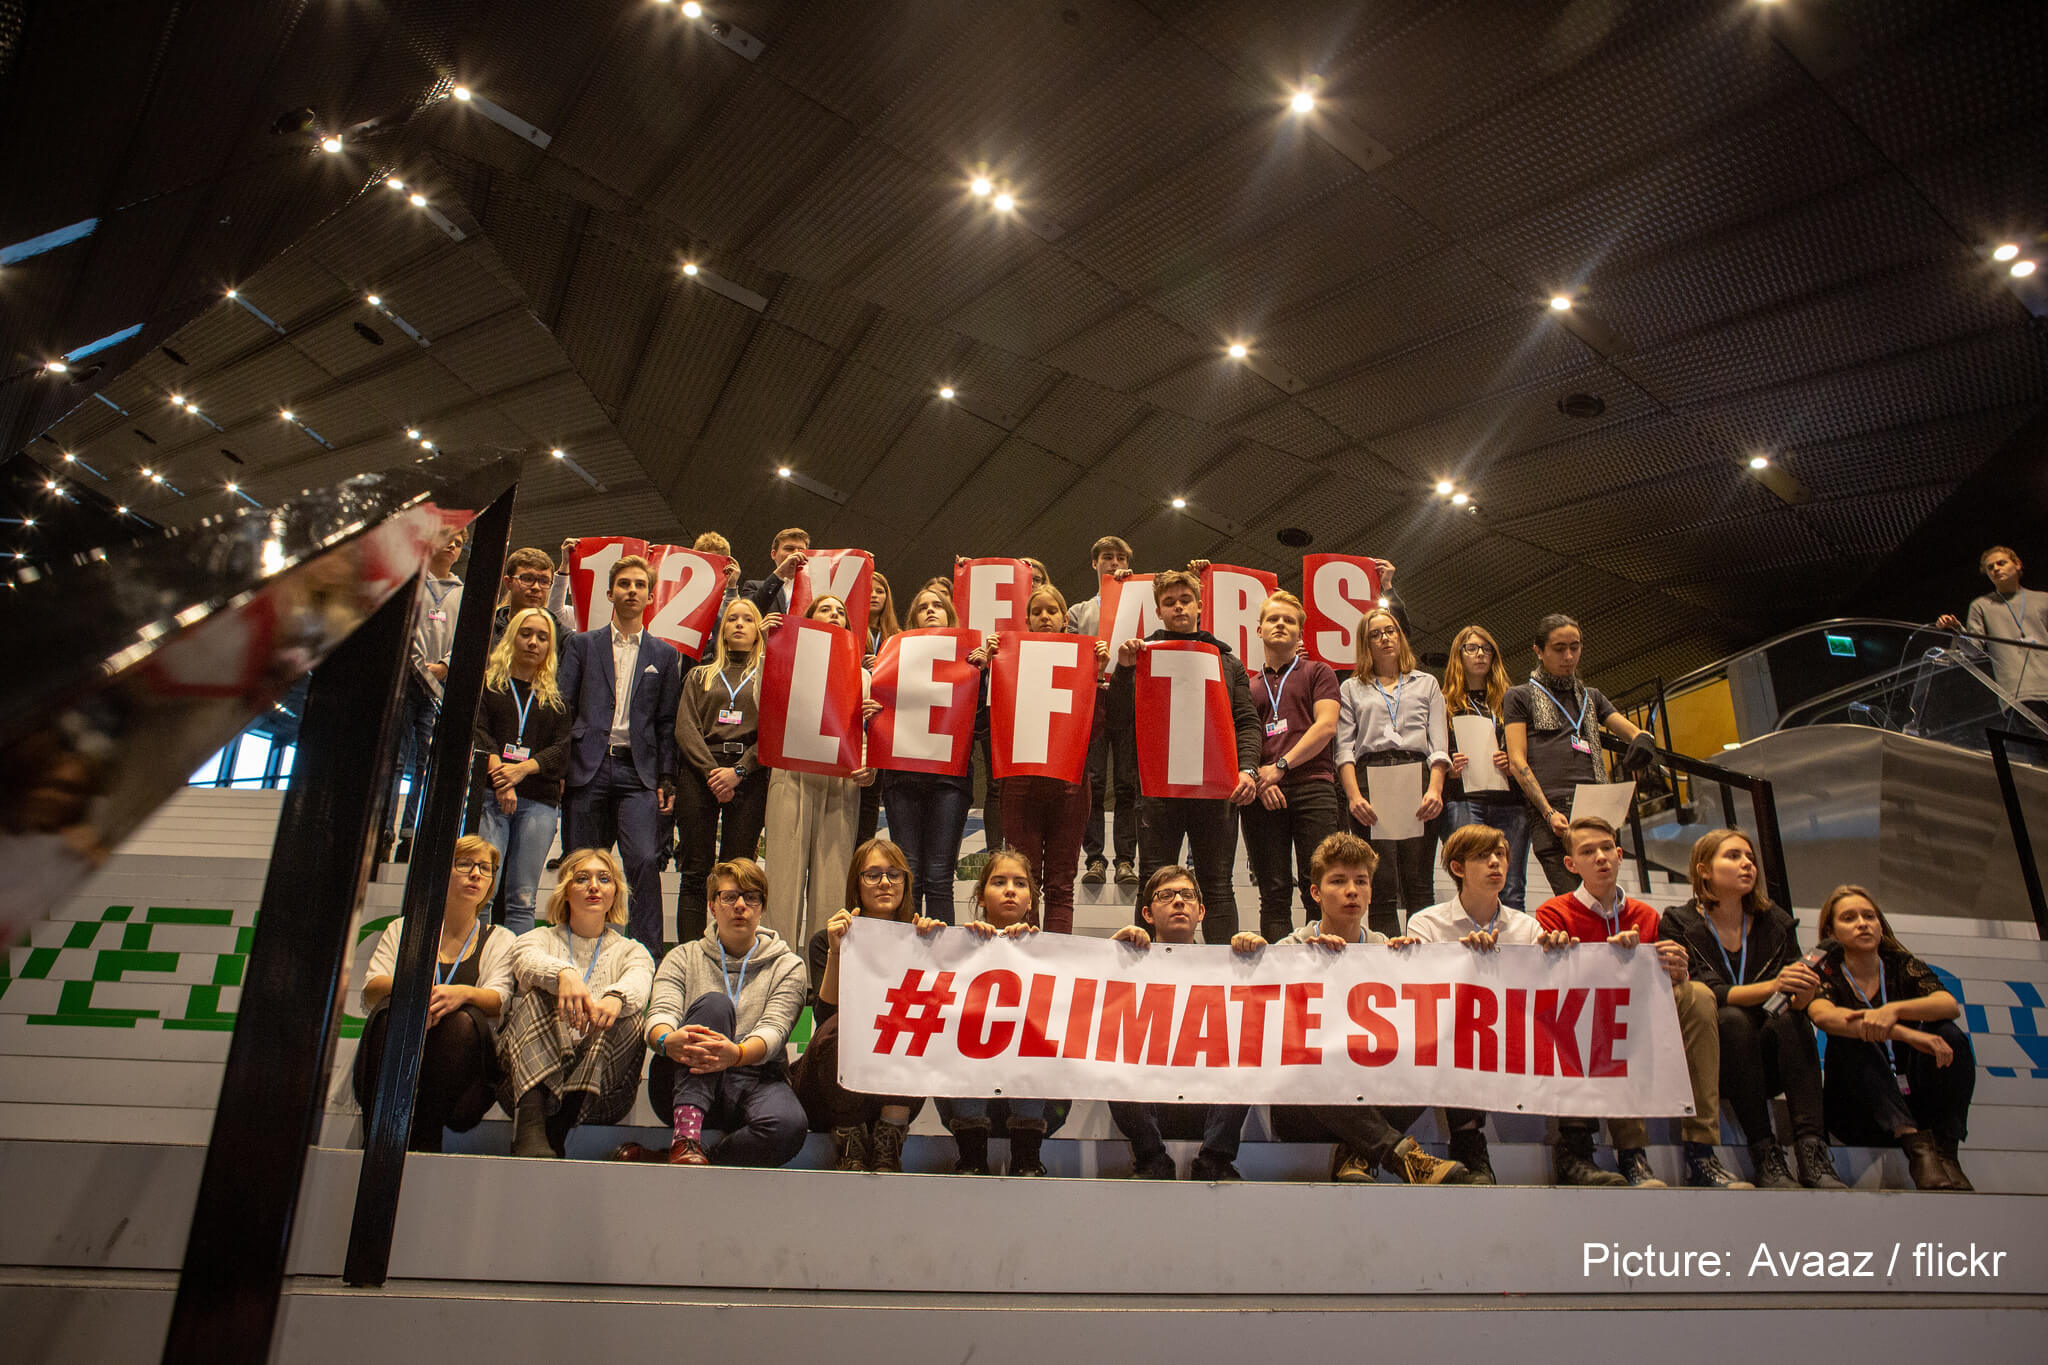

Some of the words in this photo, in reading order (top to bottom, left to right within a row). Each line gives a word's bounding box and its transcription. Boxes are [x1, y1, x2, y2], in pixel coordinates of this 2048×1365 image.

[579, 543, 703, 651] 12
[722, 627, 1222, 786] LEFT
[873, 969, 1324, 1068] #CLIMATE
[1346, 981, 1631, 1079] STRIKE
